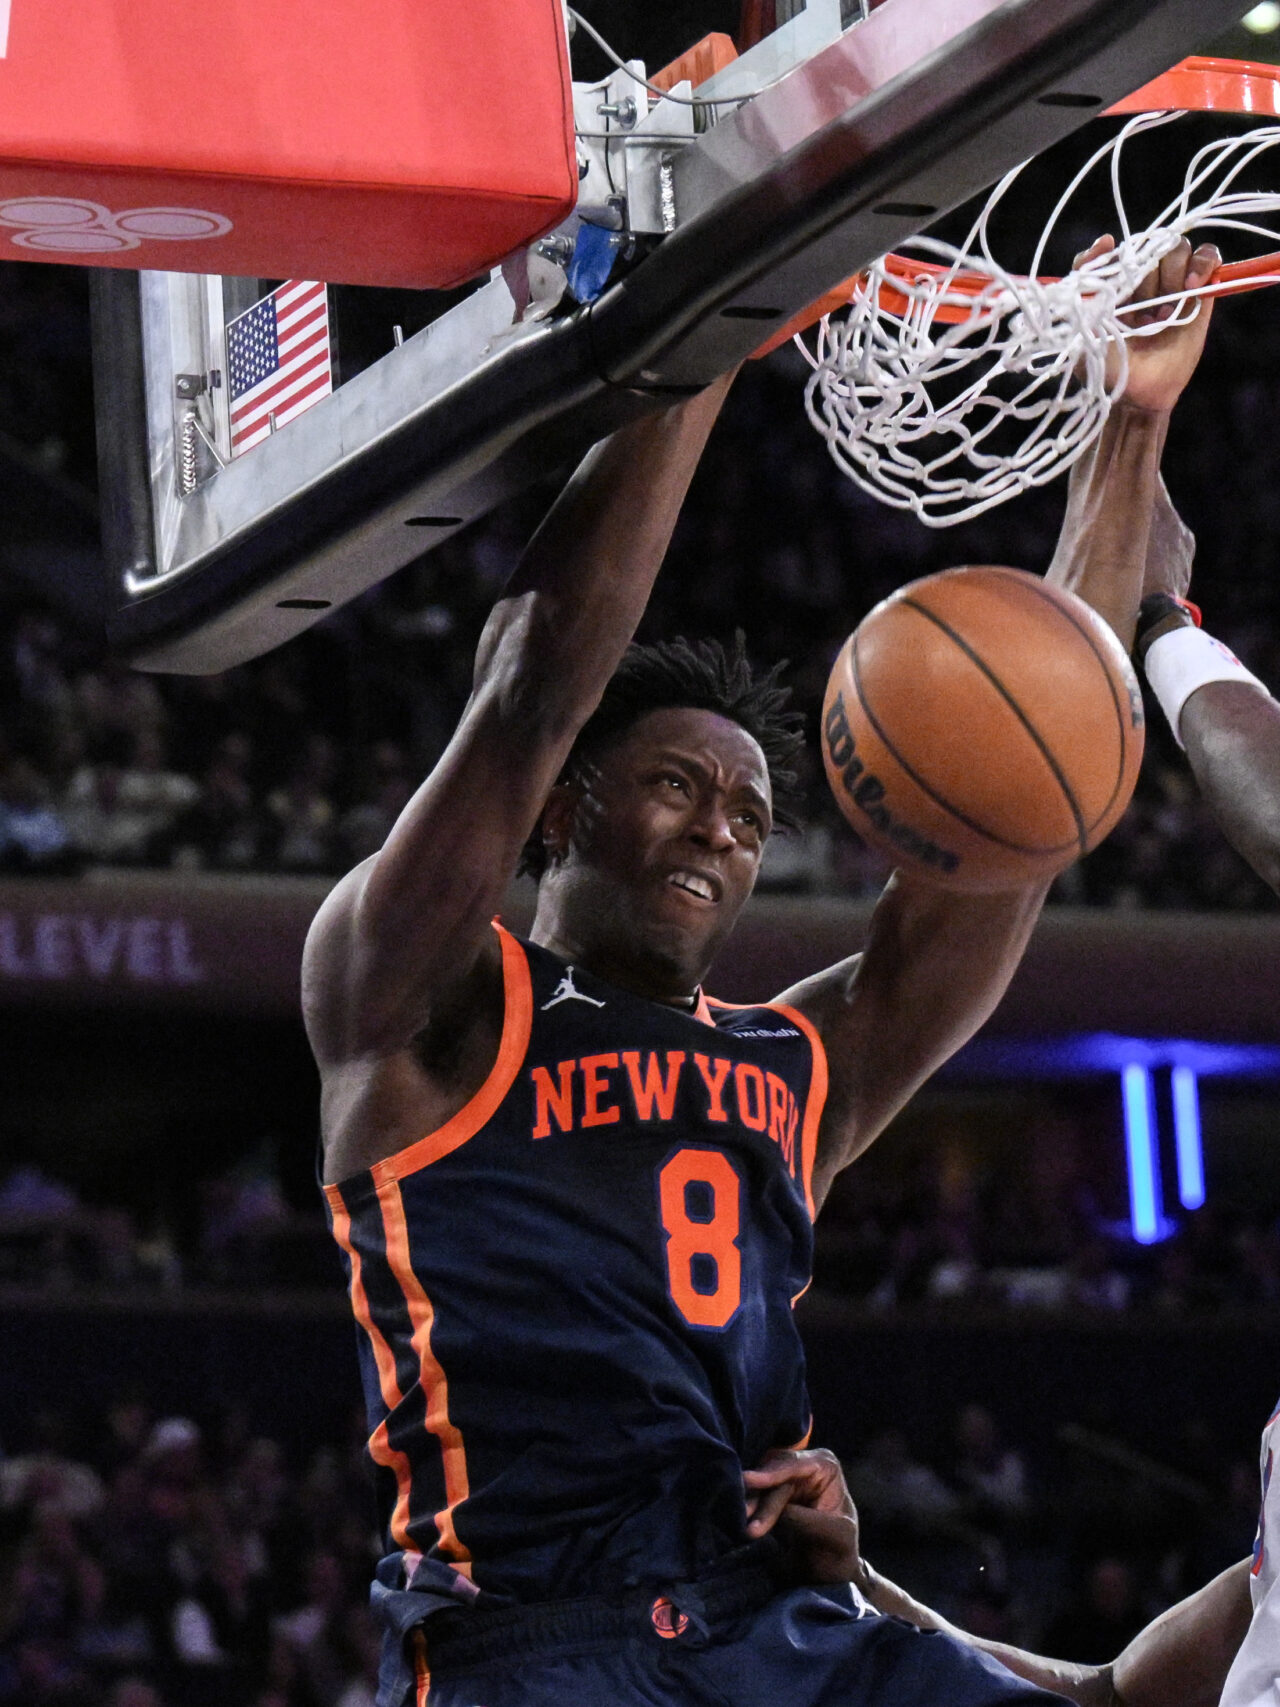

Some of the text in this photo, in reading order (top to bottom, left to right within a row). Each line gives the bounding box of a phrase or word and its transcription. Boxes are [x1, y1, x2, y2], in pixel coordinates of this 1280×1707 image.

[0, 912, 203, 981] LEVEL
[531, 1050, 799, 1179] NEW YORK
[659, 1148, 742, 1328] 8
